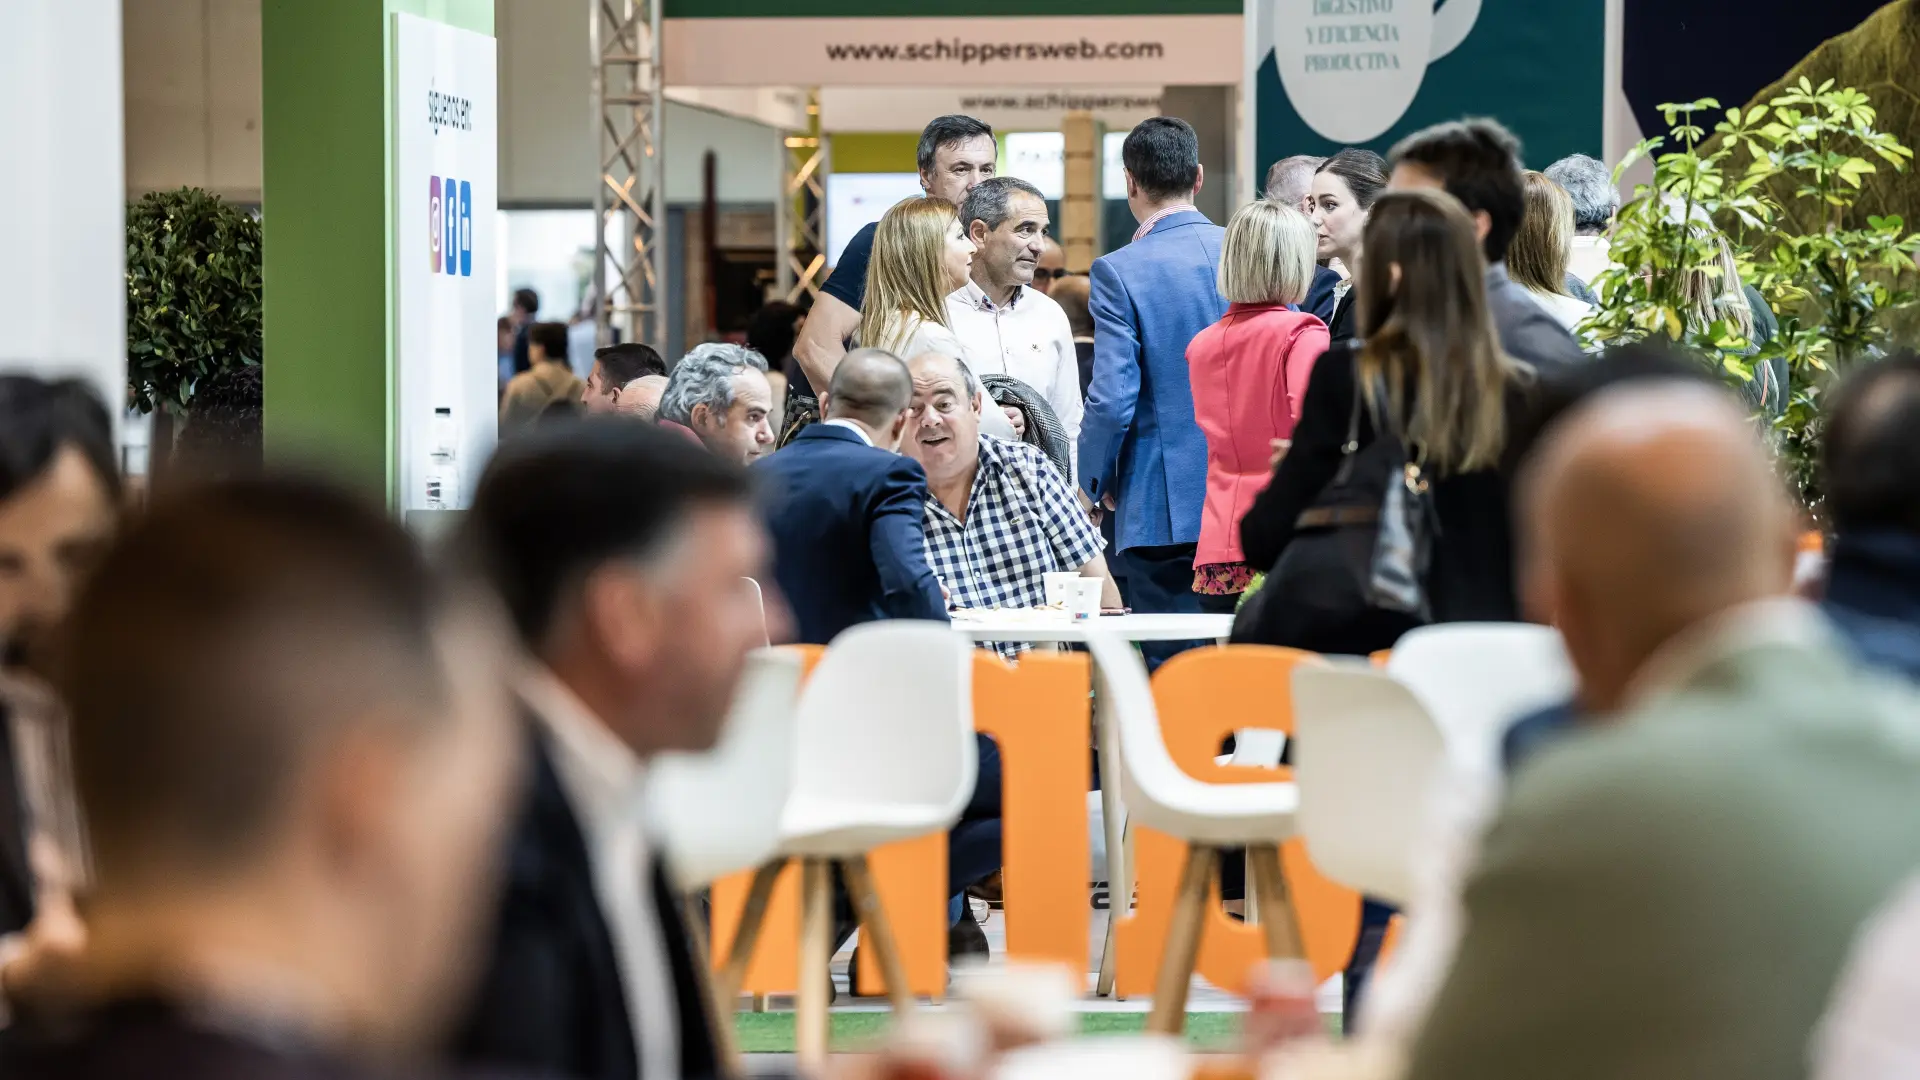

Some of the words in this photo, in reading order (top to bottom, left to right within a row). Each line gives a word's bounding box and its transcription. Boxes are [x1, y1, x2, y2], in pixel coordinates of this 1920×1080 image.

[1306, 26, 1314, 44] Y
[1318, 23, 1400, 44] EFICIENCIA
[825, 39, 1164, 64] www.schippersweb.com
[1304, 52, 1401, 73] PRODUCTIVA
